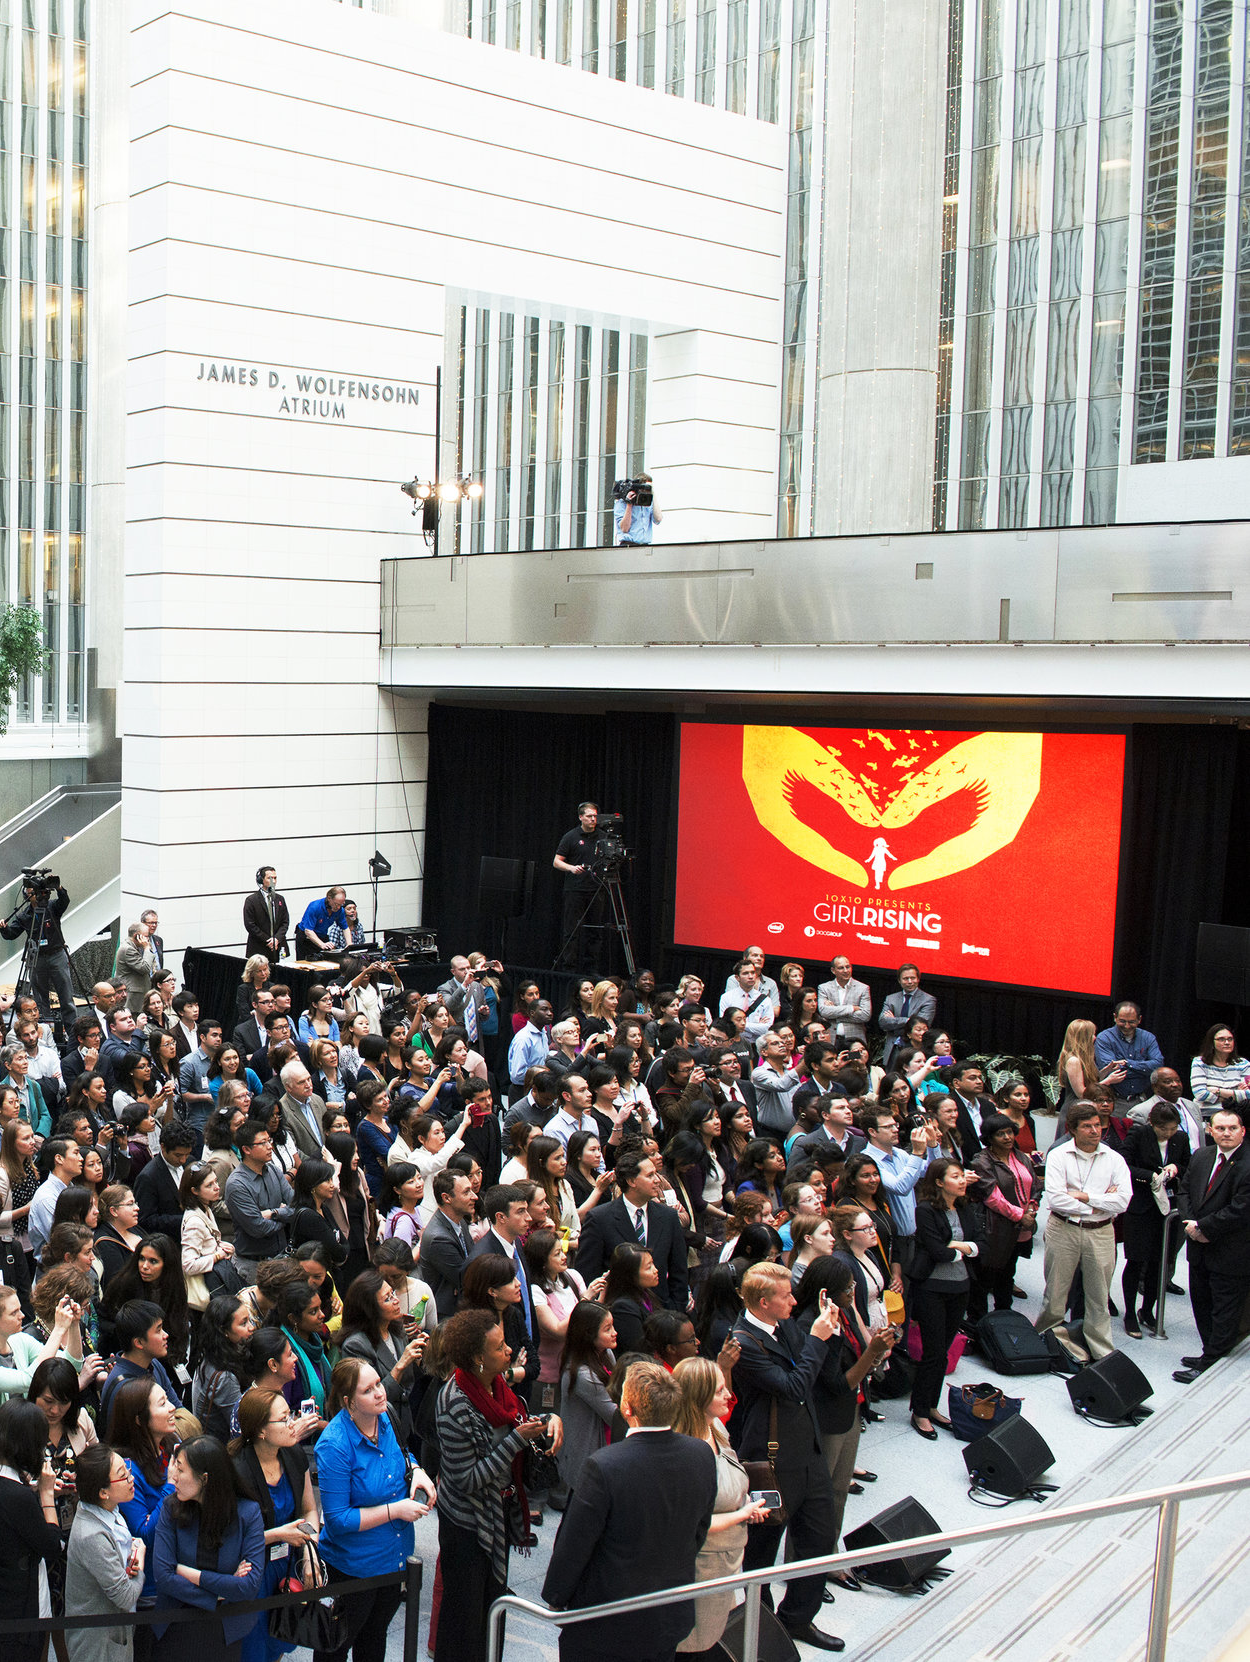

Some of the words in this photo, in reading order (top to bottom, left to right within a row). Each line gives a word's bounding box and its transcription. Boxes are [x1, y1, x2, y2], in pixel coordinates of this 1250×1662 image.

[197, 362, 259, 387] JAMES
[268, 371, 287, 390] D.
[296, 374, 420, 406] WOLFENSOHN
[278, 396, 346, 419] ATRIUM
[825, 894, 862, 905] 10X10
[868, 897, 931, 912] PRESENTS
